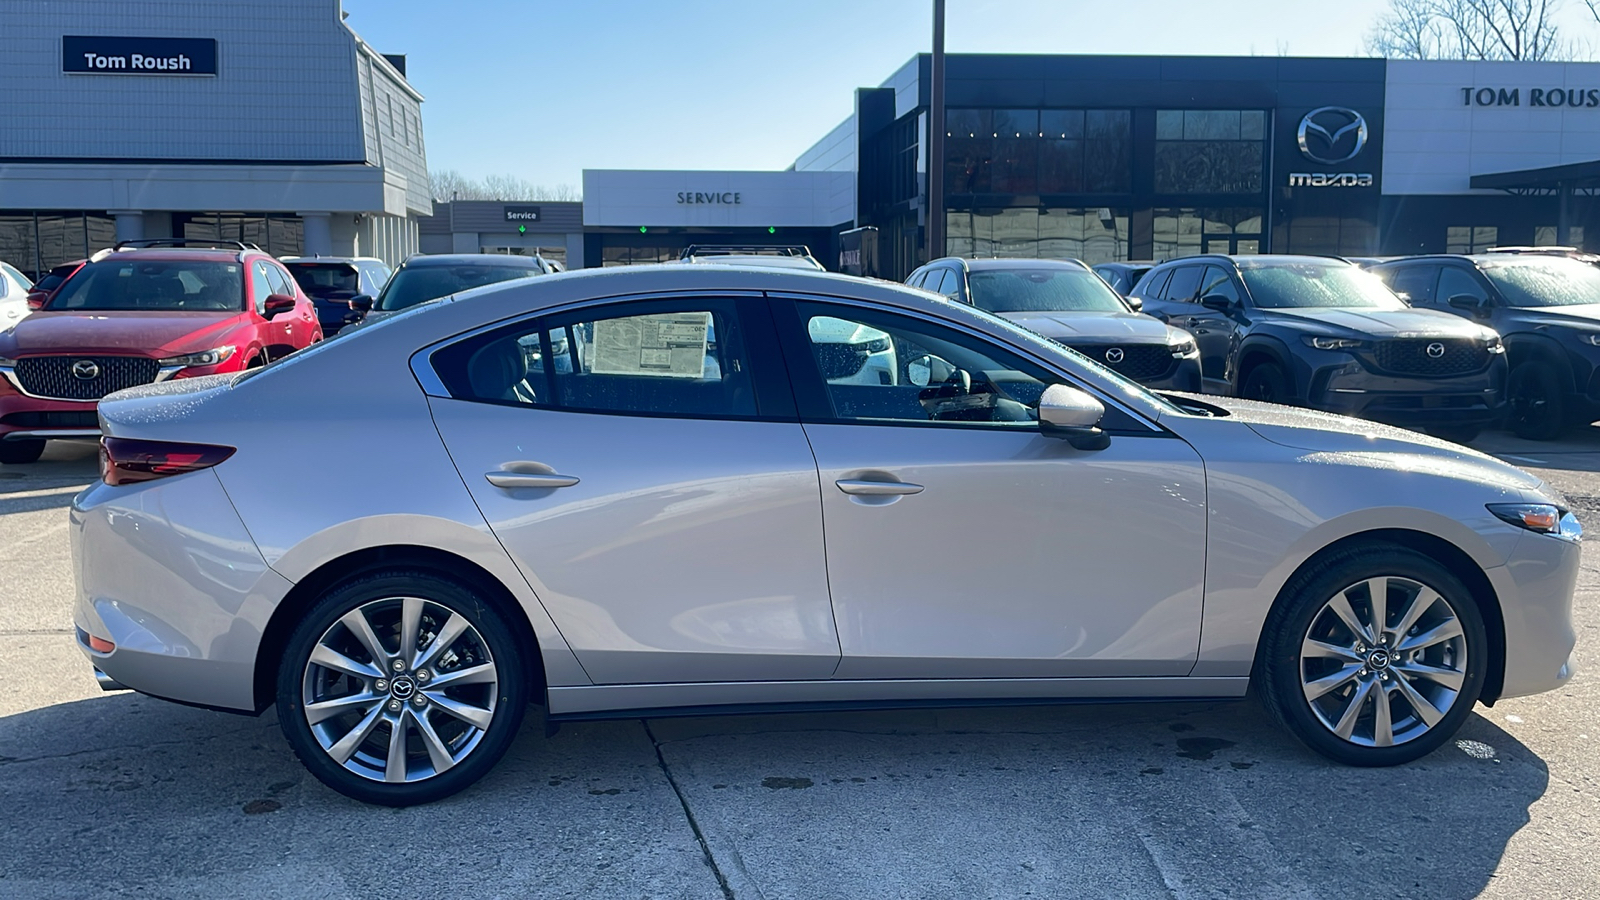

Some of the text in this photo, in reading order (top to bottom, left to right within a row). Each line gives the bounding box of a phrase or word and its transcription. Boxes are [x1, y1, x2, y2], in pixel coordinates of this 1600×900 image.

[84, 53, 191, 70] Tom Roush
[1461, 87, 1520, 107] TOM
[676, 191, 742, 205] SERVICE
[507, 211, 537, 220] Service
